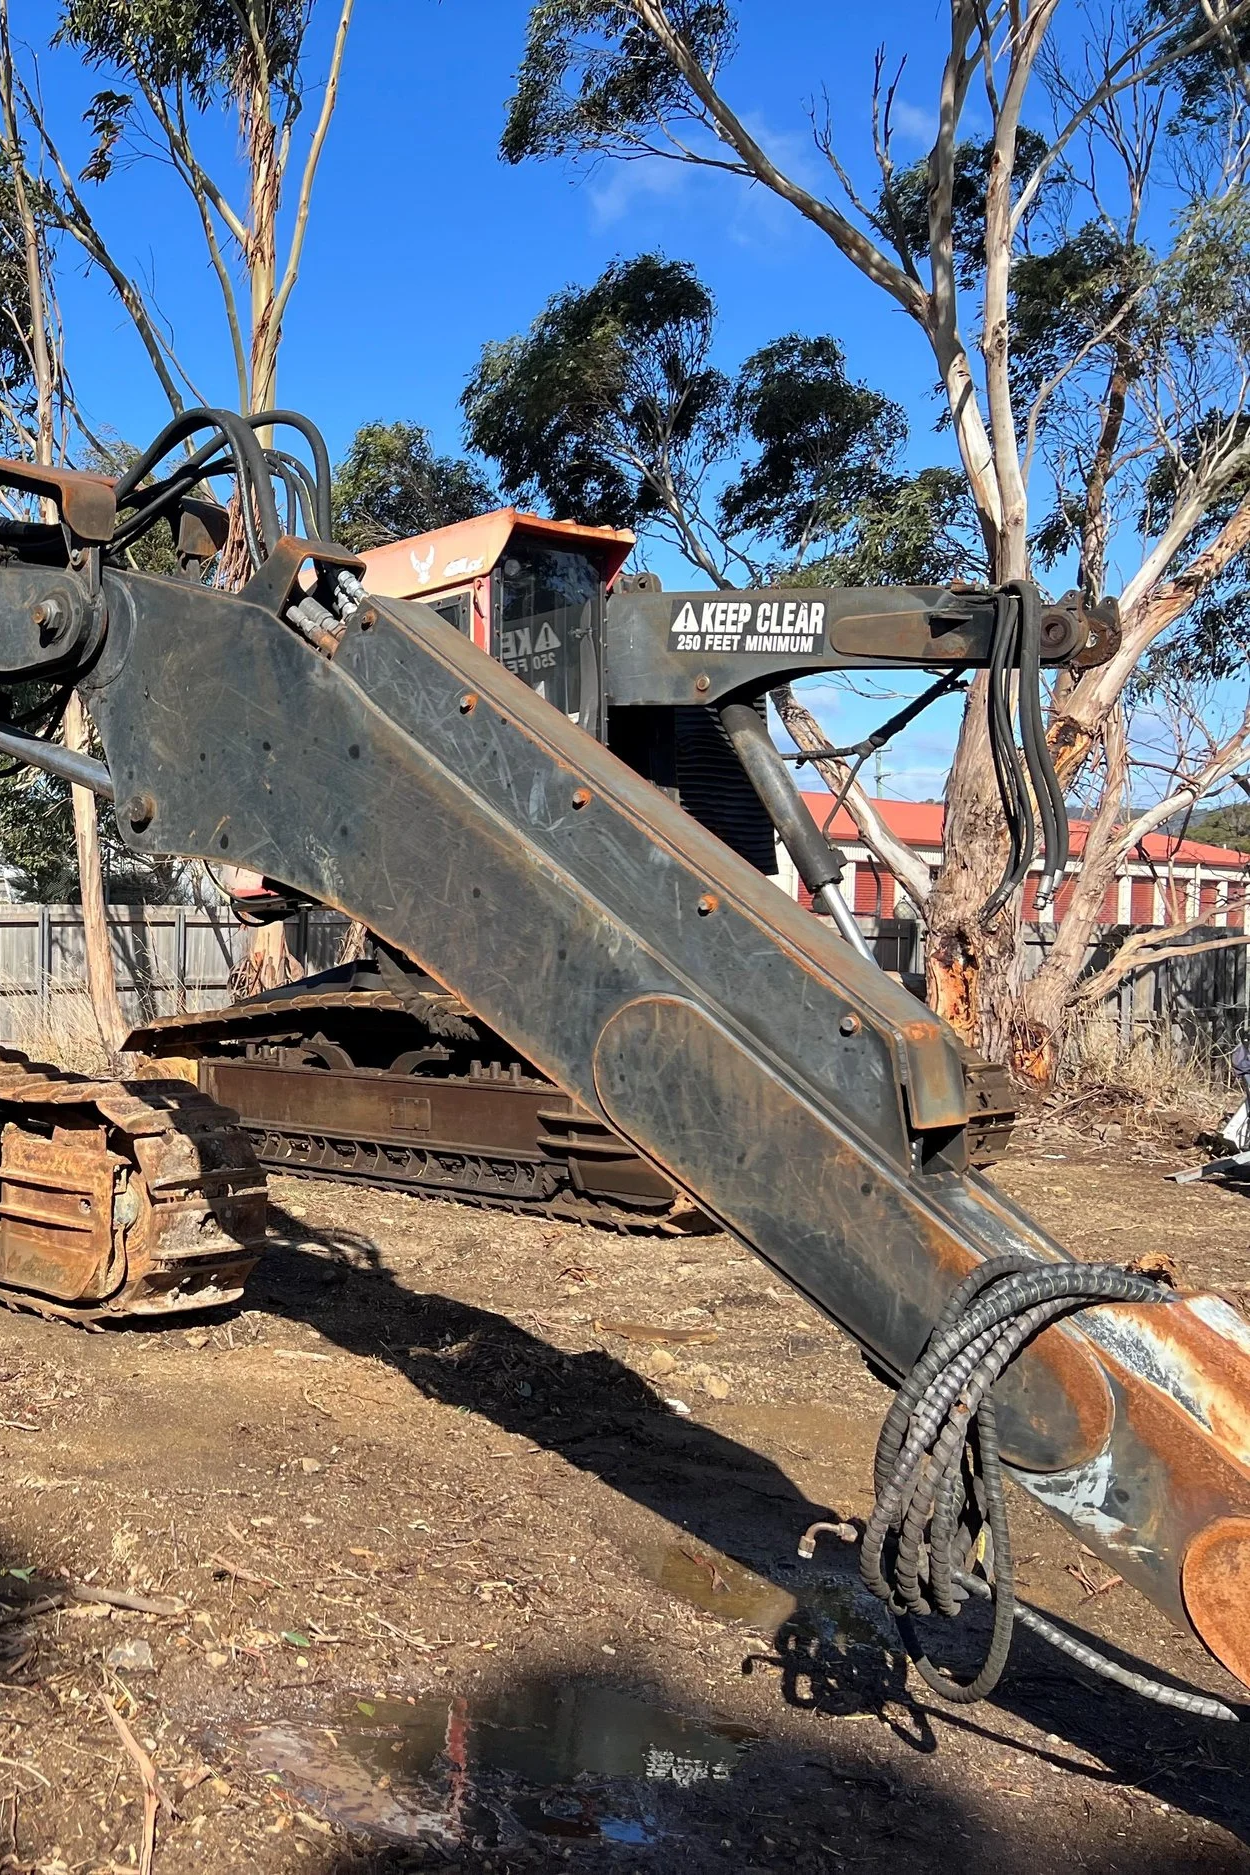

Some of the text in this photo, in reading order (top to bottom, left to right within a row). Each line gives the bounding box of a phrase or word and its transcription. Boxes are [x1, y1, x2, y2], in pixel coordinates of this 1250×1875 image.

[701, 602, 825, 635] KEEP CLEAR
[677, 634, 814, 653] 250 FEET MINIMUM
